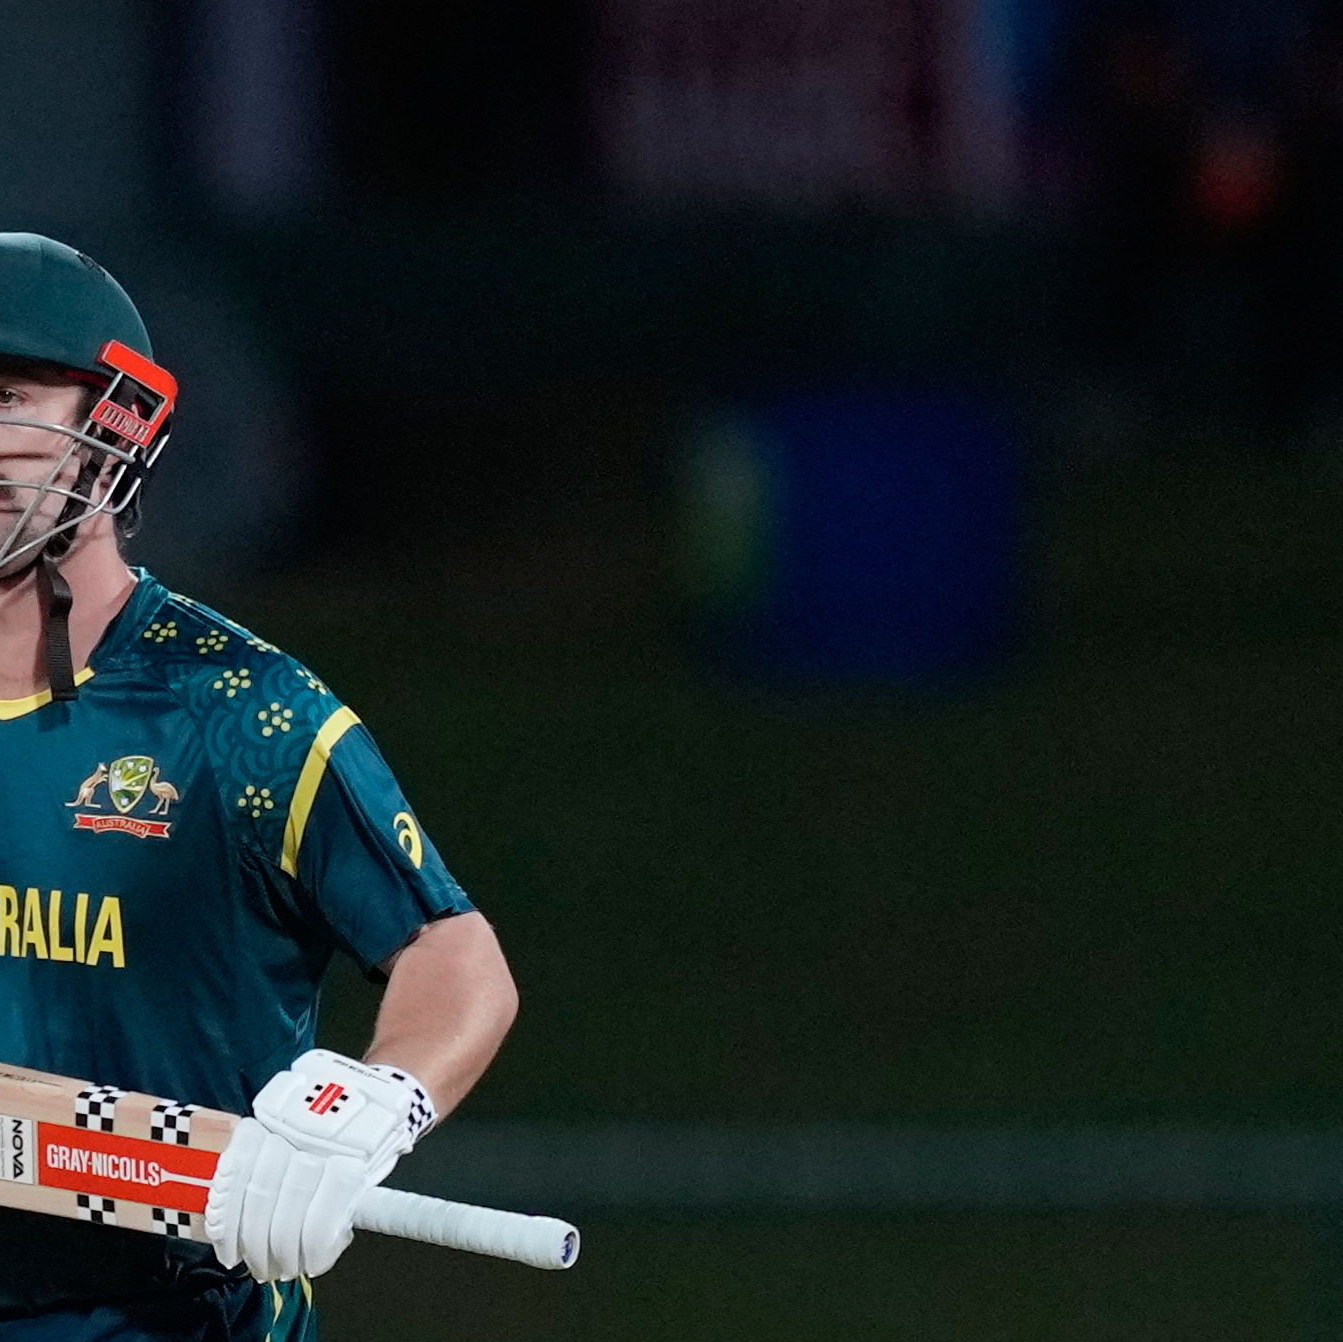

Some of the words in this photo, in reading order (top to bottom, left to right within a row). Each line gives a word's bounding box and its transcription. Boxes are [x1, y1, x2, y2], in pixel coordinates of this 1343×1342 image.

[96, 818, 147, 834] AUSTRALIA
[12, 1119, 24, 1179] NOVA
[46, 1144, 162, 1187] GRAY-NICOLLS
